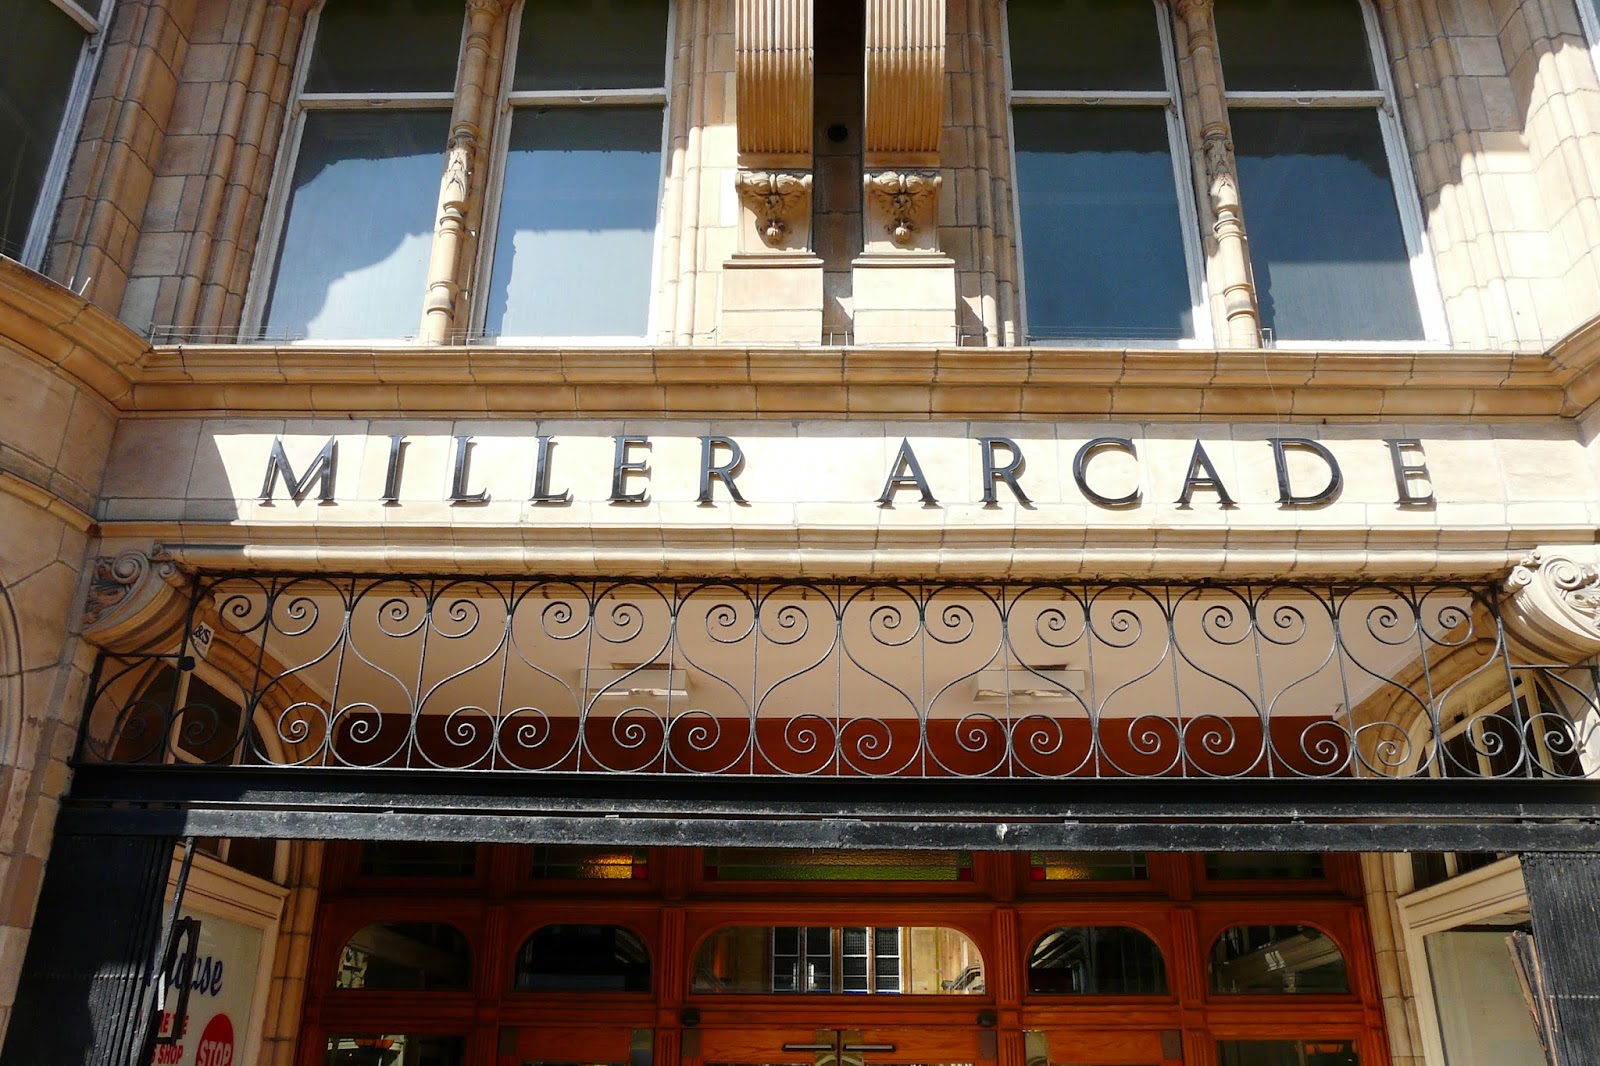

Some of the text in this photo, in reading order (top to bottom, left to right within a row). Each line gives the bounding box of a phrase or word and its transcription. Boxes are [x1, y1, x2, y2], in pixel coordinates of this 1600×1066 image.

[259, 434, 1434, 506] MILLER ARCADE
[199, 1040, 232, 1066] STOP
